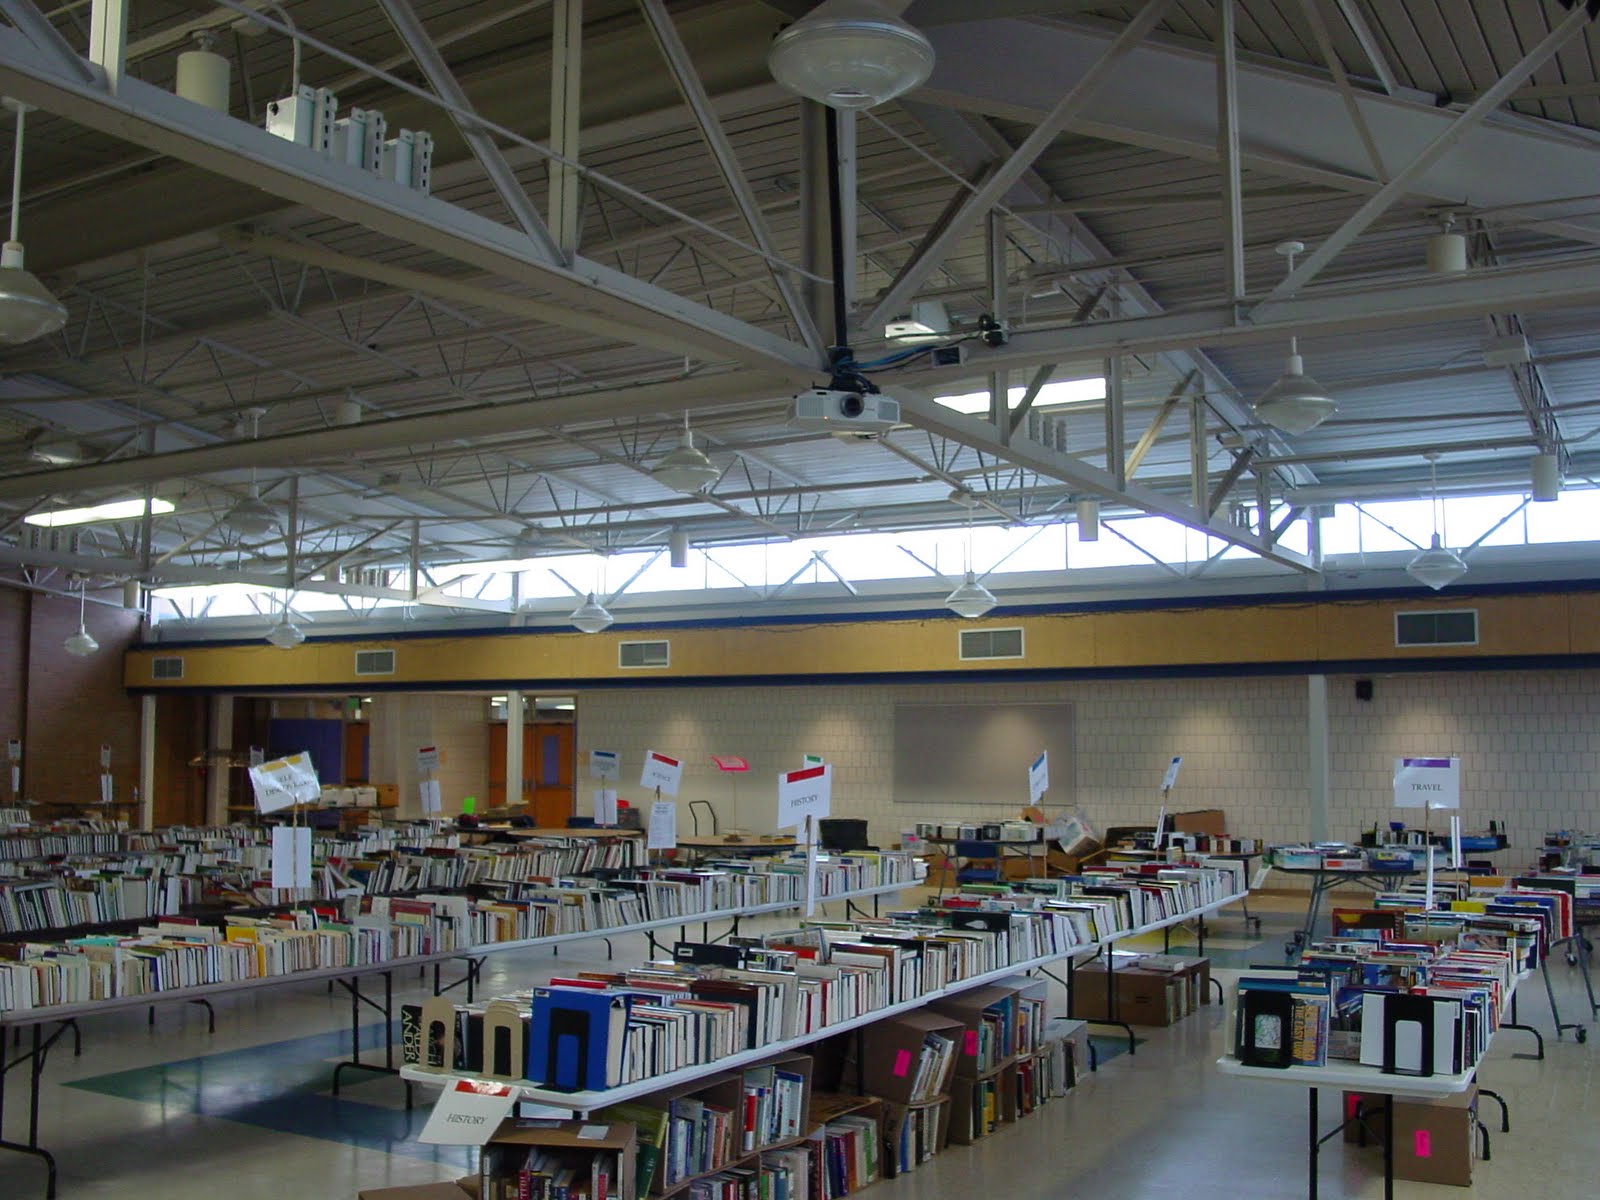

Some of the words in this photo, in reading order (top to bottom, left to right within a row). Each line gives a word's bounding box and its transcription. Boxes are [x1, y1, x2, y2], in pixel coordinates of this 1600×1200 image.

[1411, 783, 1444, 792] TRAVEL
[402, 1010, 415, 1060] ANDER
[446, 1113, 488, 1125] HISTORY
